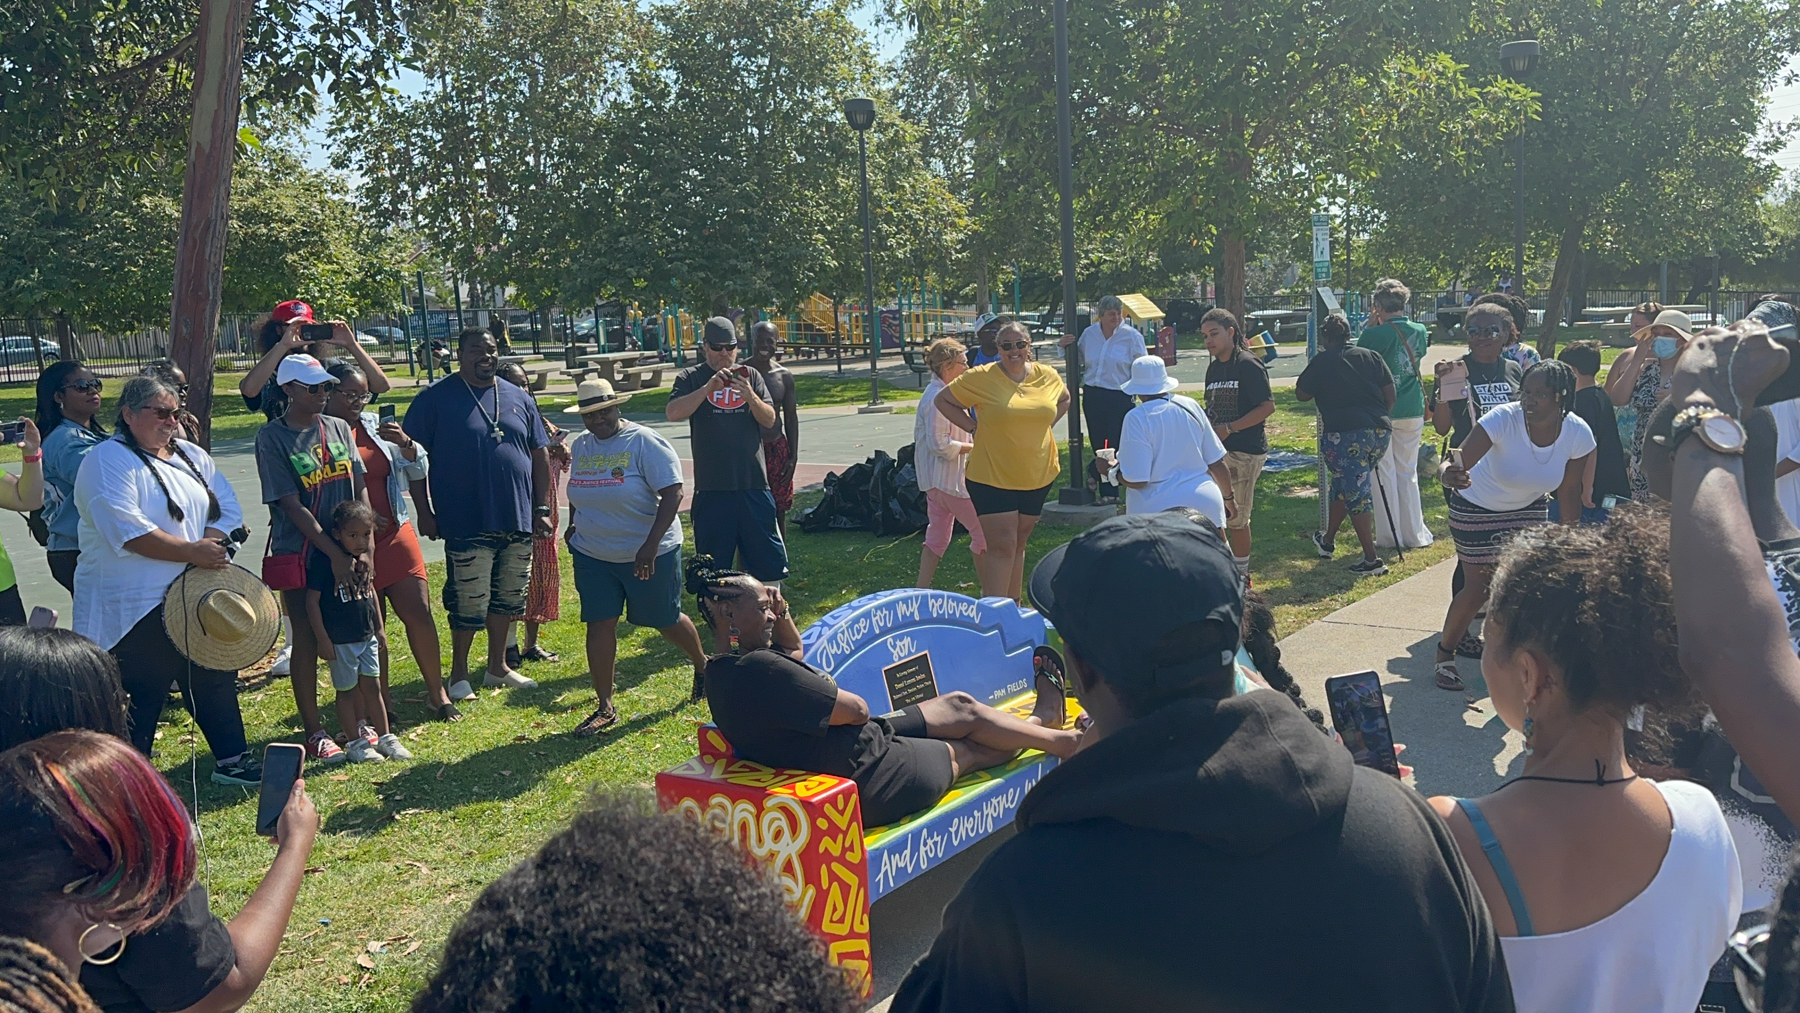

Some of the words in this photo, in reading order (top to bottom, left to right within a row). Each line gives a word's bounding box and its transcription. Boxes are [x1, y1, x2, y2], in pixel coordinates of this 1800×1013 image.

[1475, 383, 1510, 393] STAND
[1480, 394, 1507, 402] WITH
[289, 442, 350, 476] BOB
[817, 618, 870, 672] Justice
[871, 607, 894, 634] for
[896, 593, 922, 621] my
[927, 592, 982, 624] beloved
[886, 635, 917, 662] Son
[1007, 678, 1028, 694] FIELDS
[875, 832, 918, 894] And
[919, 827, 948, 870] for
[948, 787, 1021, 847] everyone
